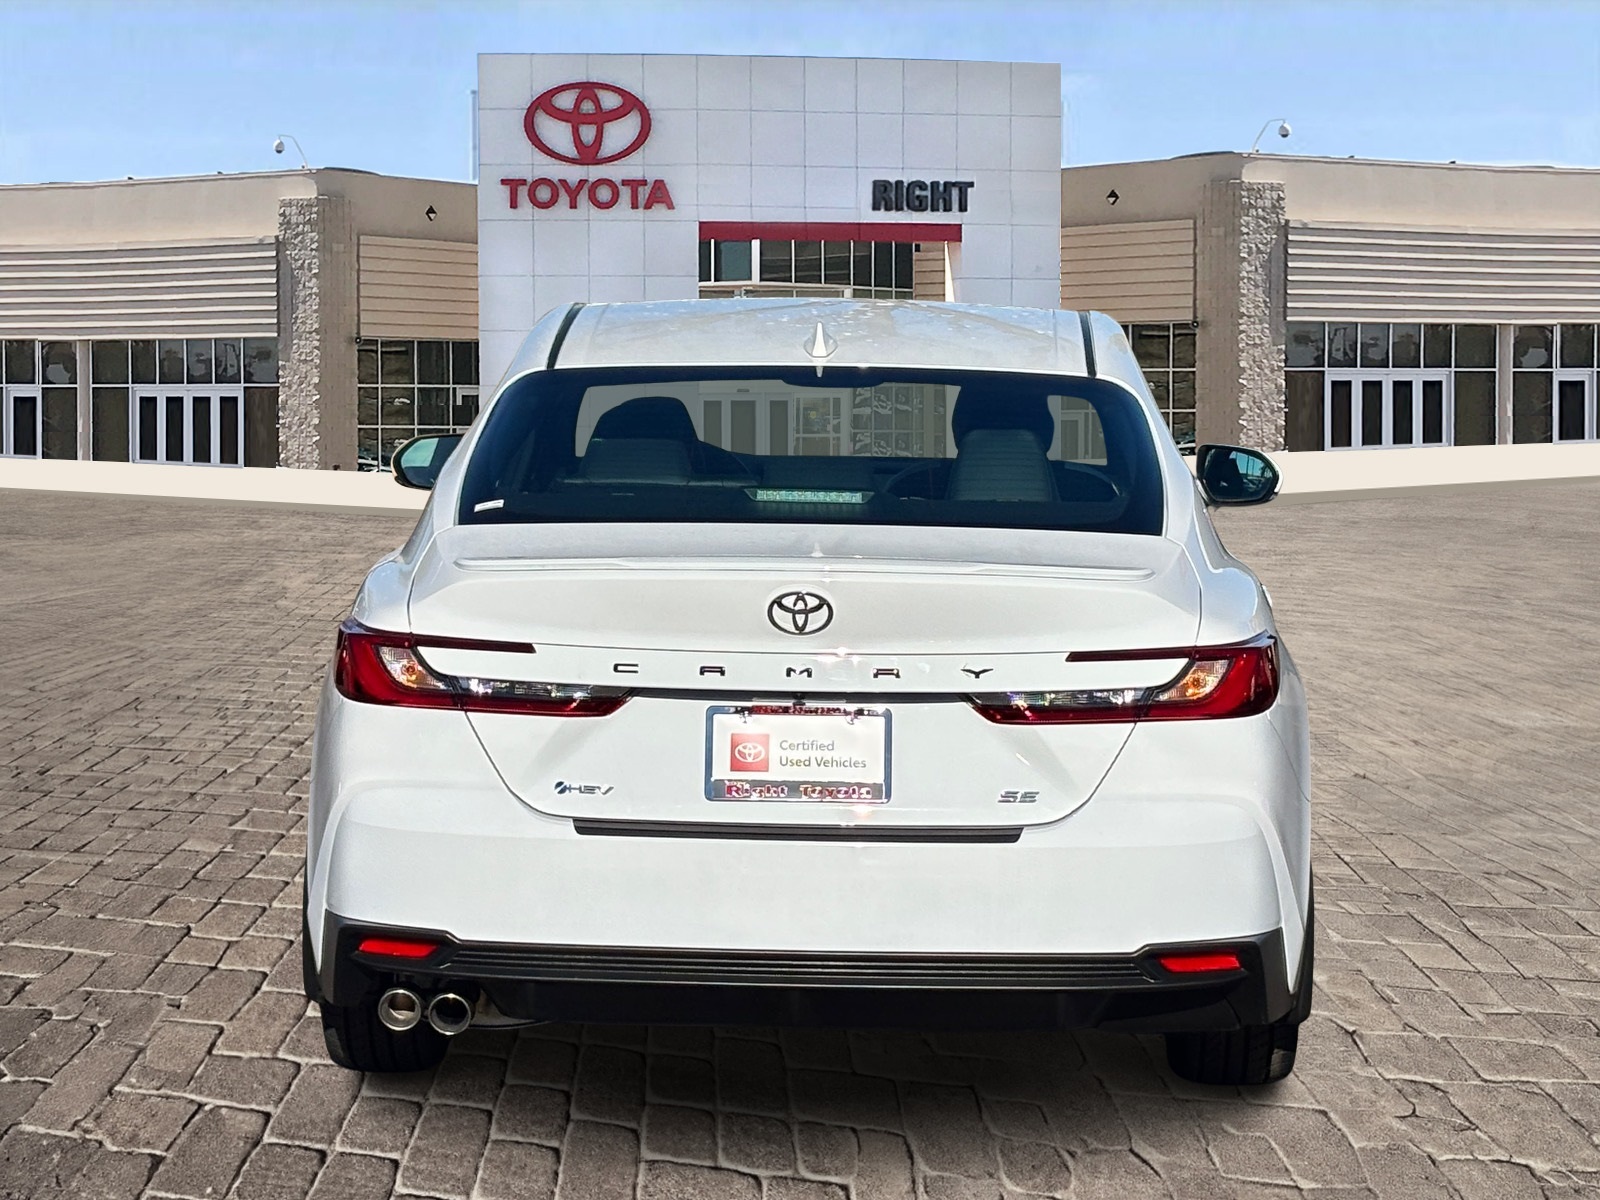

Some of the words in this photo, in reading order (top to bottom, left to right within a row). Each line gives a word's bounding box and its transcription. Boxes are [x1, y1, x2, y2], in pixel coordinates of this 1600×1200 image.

[500, 178, 675, 210] TOYOTA
[872, 180, 975, 213] RIGHT
[779, 739, 835, 751] Certified
[779, 756, 811, 767] Used
[815, 757, 867, 768] Vehicles
[997, 791, 1039, 803] SE
